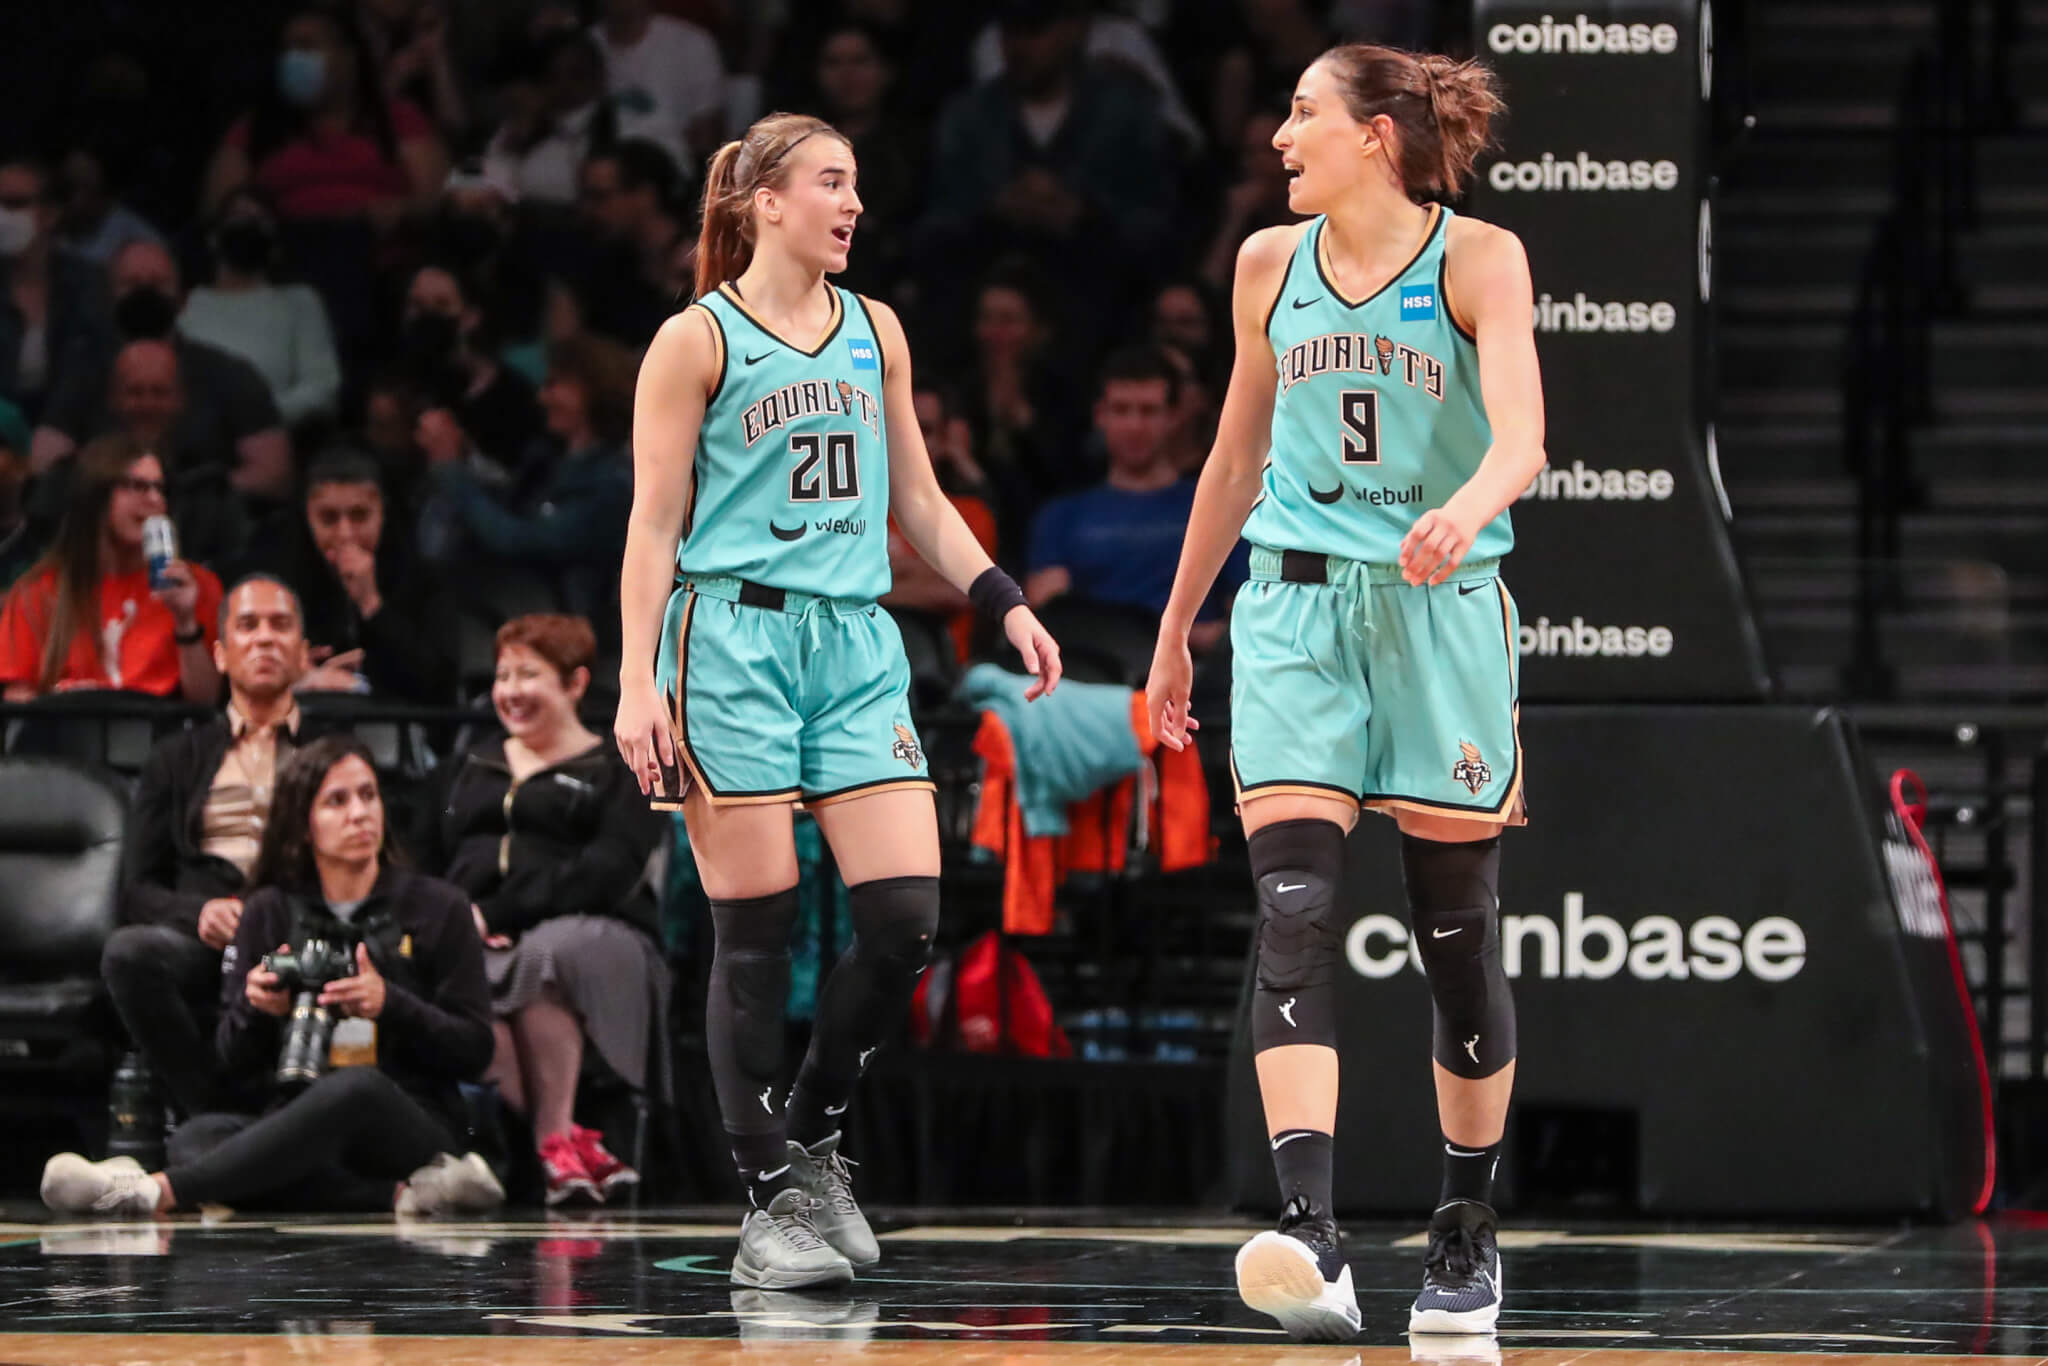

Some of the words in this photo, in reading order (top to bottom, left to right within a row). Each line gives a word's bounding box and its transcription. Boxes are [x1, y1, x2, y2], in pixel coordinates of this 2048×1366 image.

[1488, 15, 1678, 53] coinbase
[1489, 151, 1679, 191] coinbase
[1403, 295, 1433, 309] HSS
[1533, 293, 1676, 332] inbase
[851, 348, 873, 360] HSS
[1340, 390, 1381, 465] 9
[789, 431, 863, 502] 20
[1519, 460, 1675, 500] inbase
[815, 518, 866, 536] webull
[1519, 616, 1674, 657] oinbase
[1345, 892, 1807, 982] cnbase
